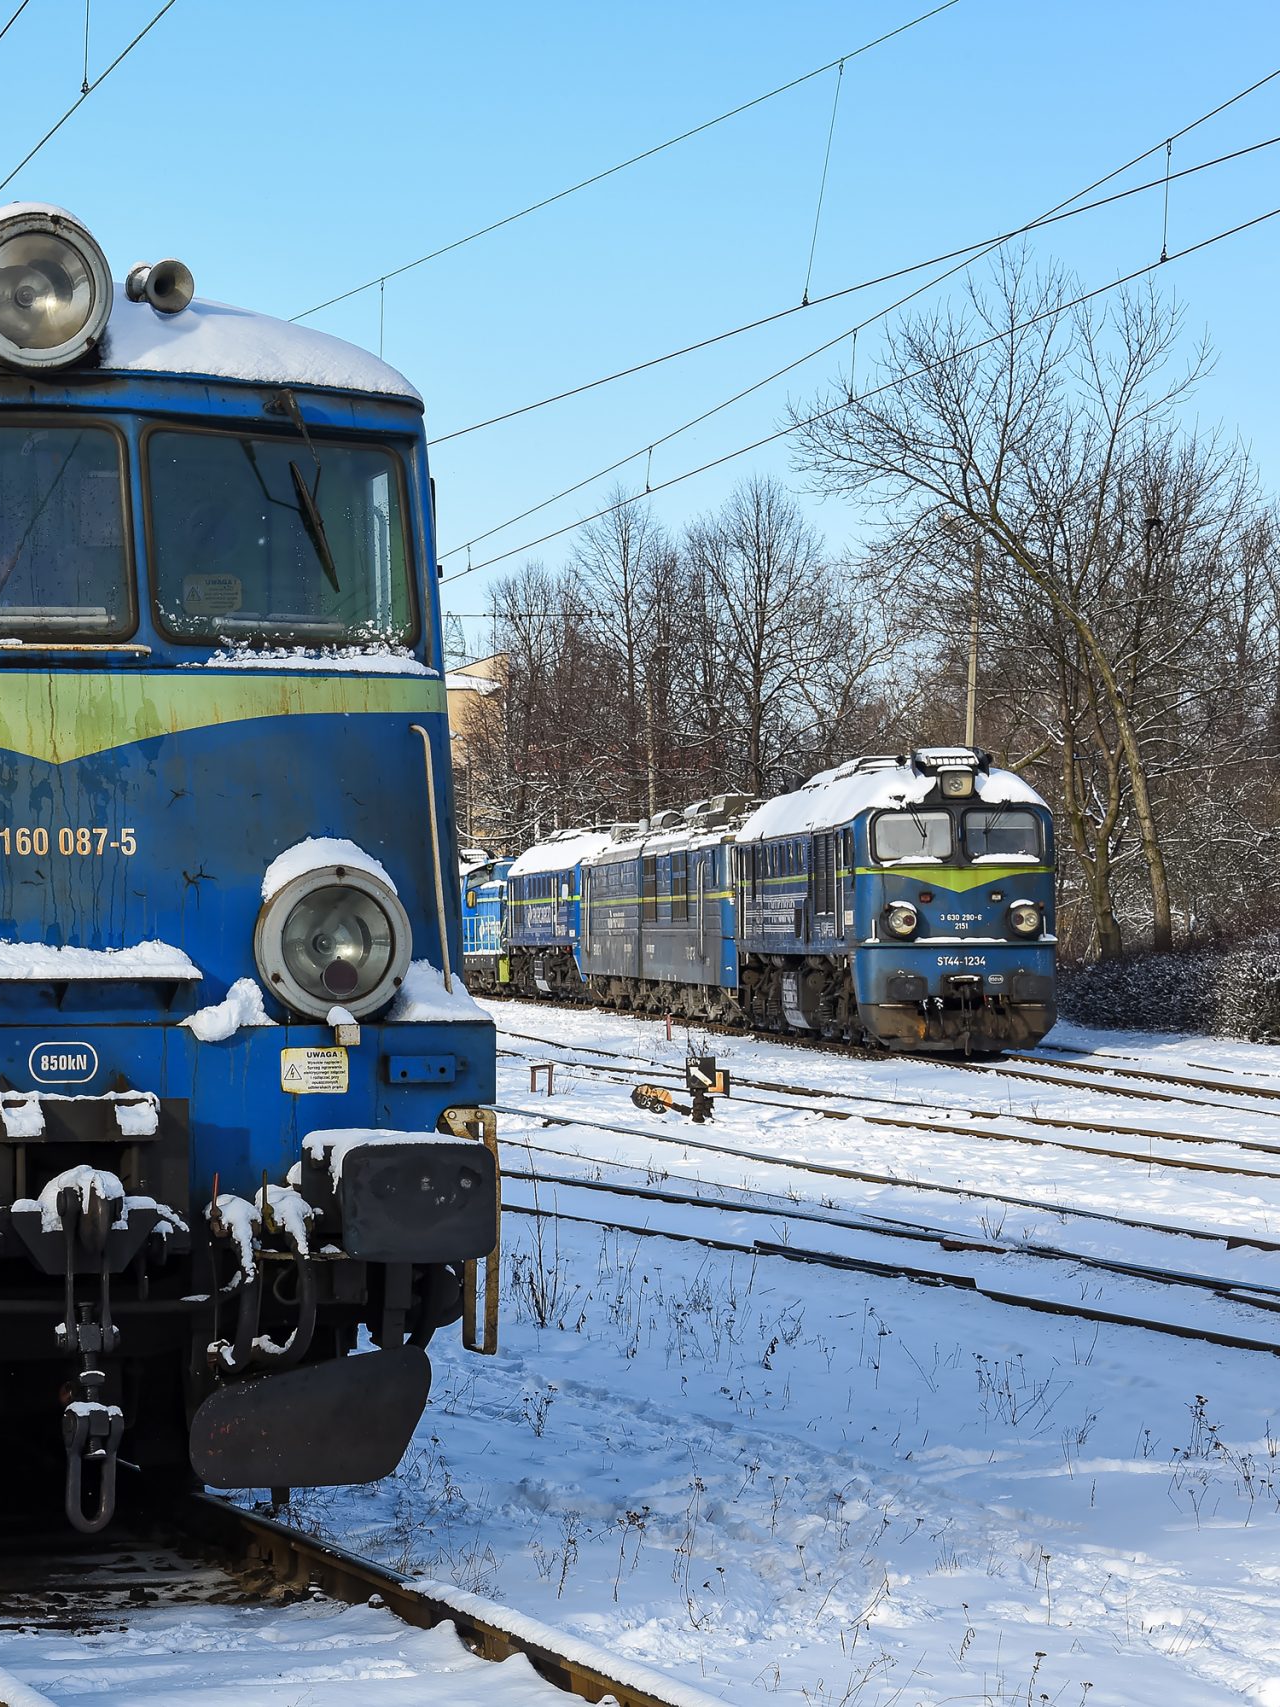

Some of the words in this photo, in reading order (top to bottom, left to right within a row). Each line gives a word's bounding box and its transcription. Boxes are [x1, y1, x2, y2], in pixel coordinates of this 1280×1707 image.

[58, 827, 137, 856] 087-5
[937, 956, 986, 966] ST44-1234
[39, 1054, 87, 1071] 850kN
